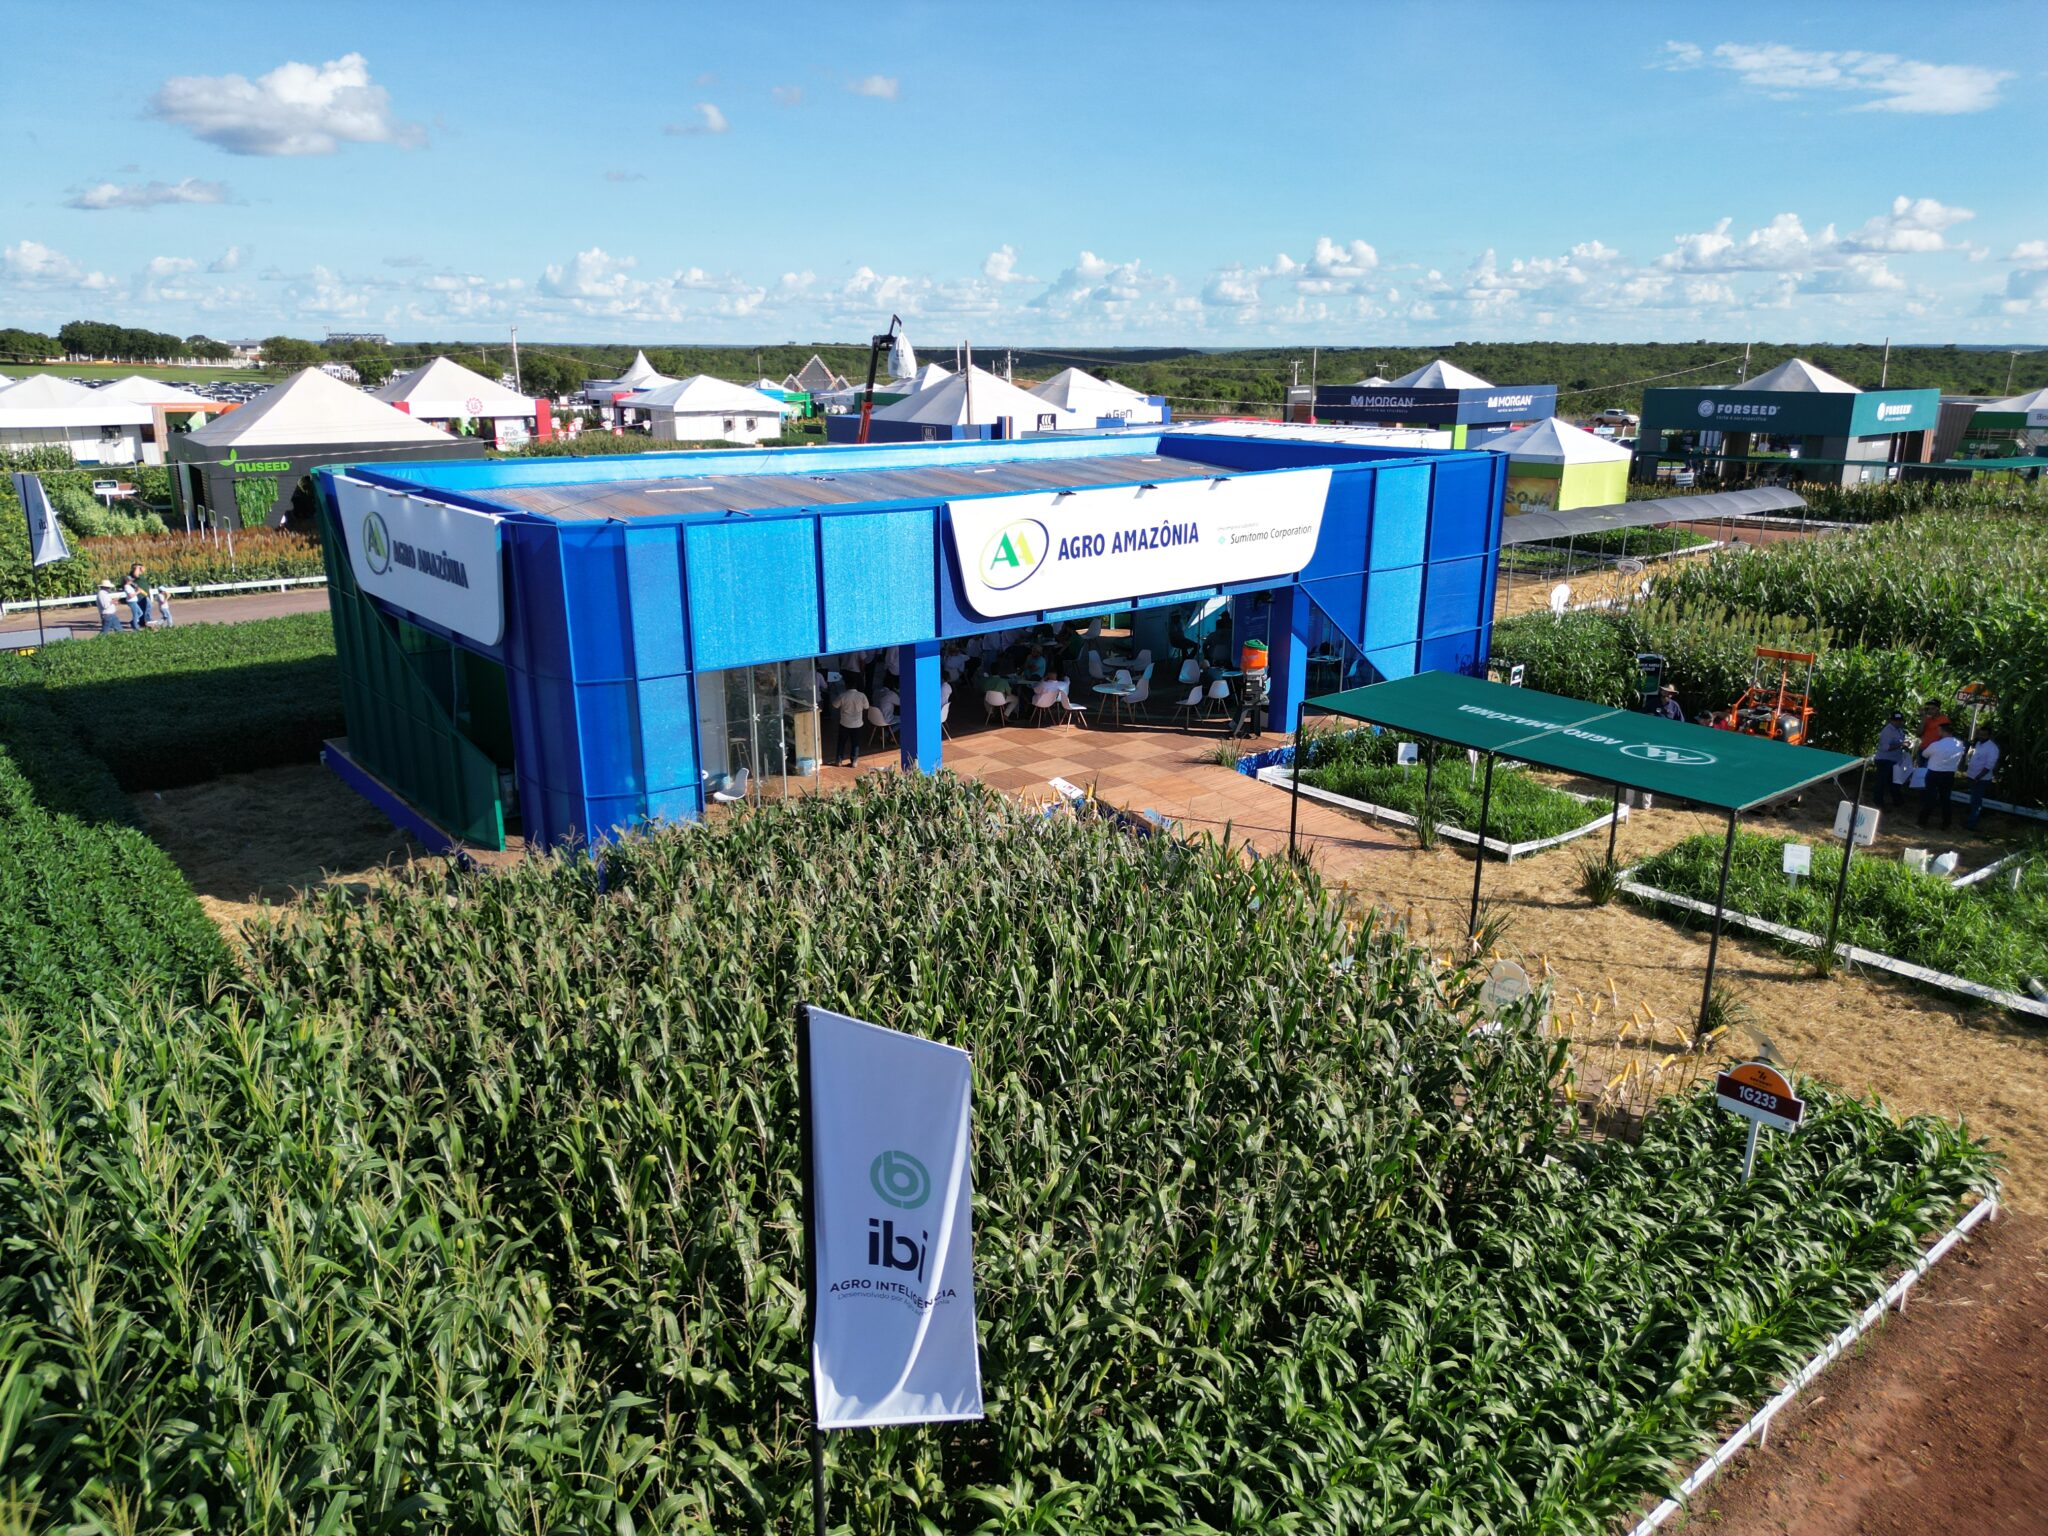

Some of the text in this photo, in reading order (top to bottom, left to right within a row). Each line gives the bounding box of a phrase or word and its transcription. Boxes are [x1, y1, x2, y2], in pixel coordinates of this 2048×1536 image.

[1365, 396, 1414, 408] MORGAN
[1498, 395, 1532, 406] MORGAN
[1717, 403, 1777, 416] FORSEED
[1058, 520, 1199, 561] AGRO AMAZÔNIA
[1230, 532, 1269, 545] Sumitomo
[1270, 525, 1312, 540] Corporation
[393, 540, 416, 569] AGRO
[1739, 1085, 1777, 1110] 1G233
[830, 1279, 872, 1293] AGRO
